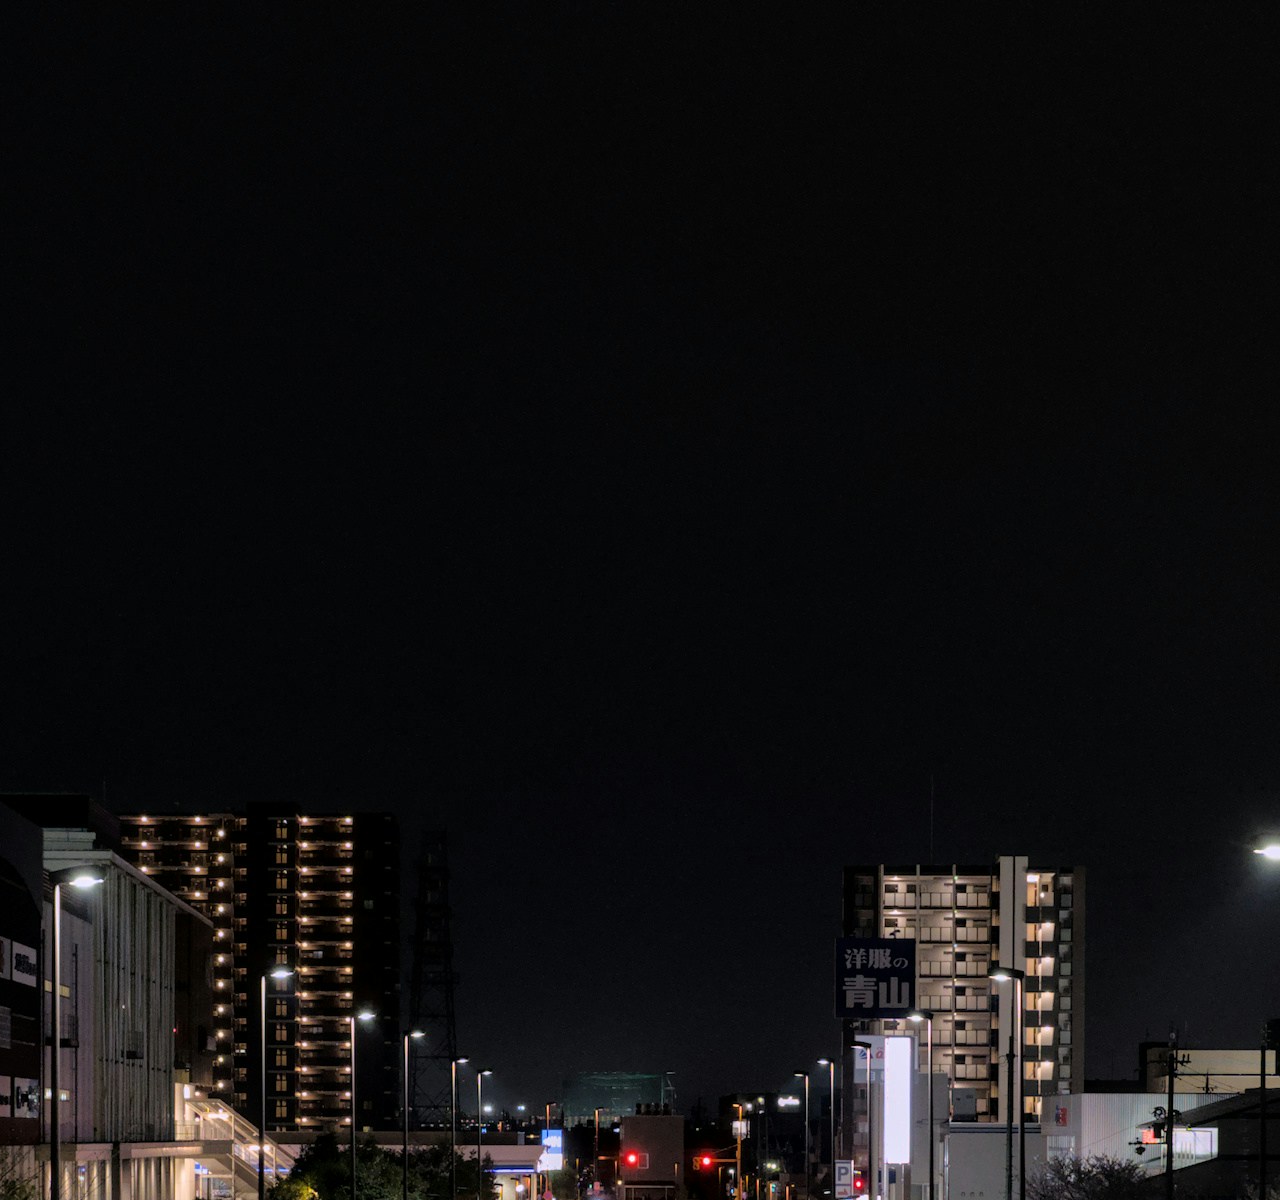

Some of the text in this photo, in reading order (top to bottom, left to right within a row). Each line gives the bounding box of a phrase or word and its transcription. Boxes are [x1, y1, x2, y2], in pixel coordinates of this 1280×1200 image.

[844, 948, 909, 970] 洋服の
[842, 974, 910, 1009] 青山
[837, 1166, 849, 1182] P
